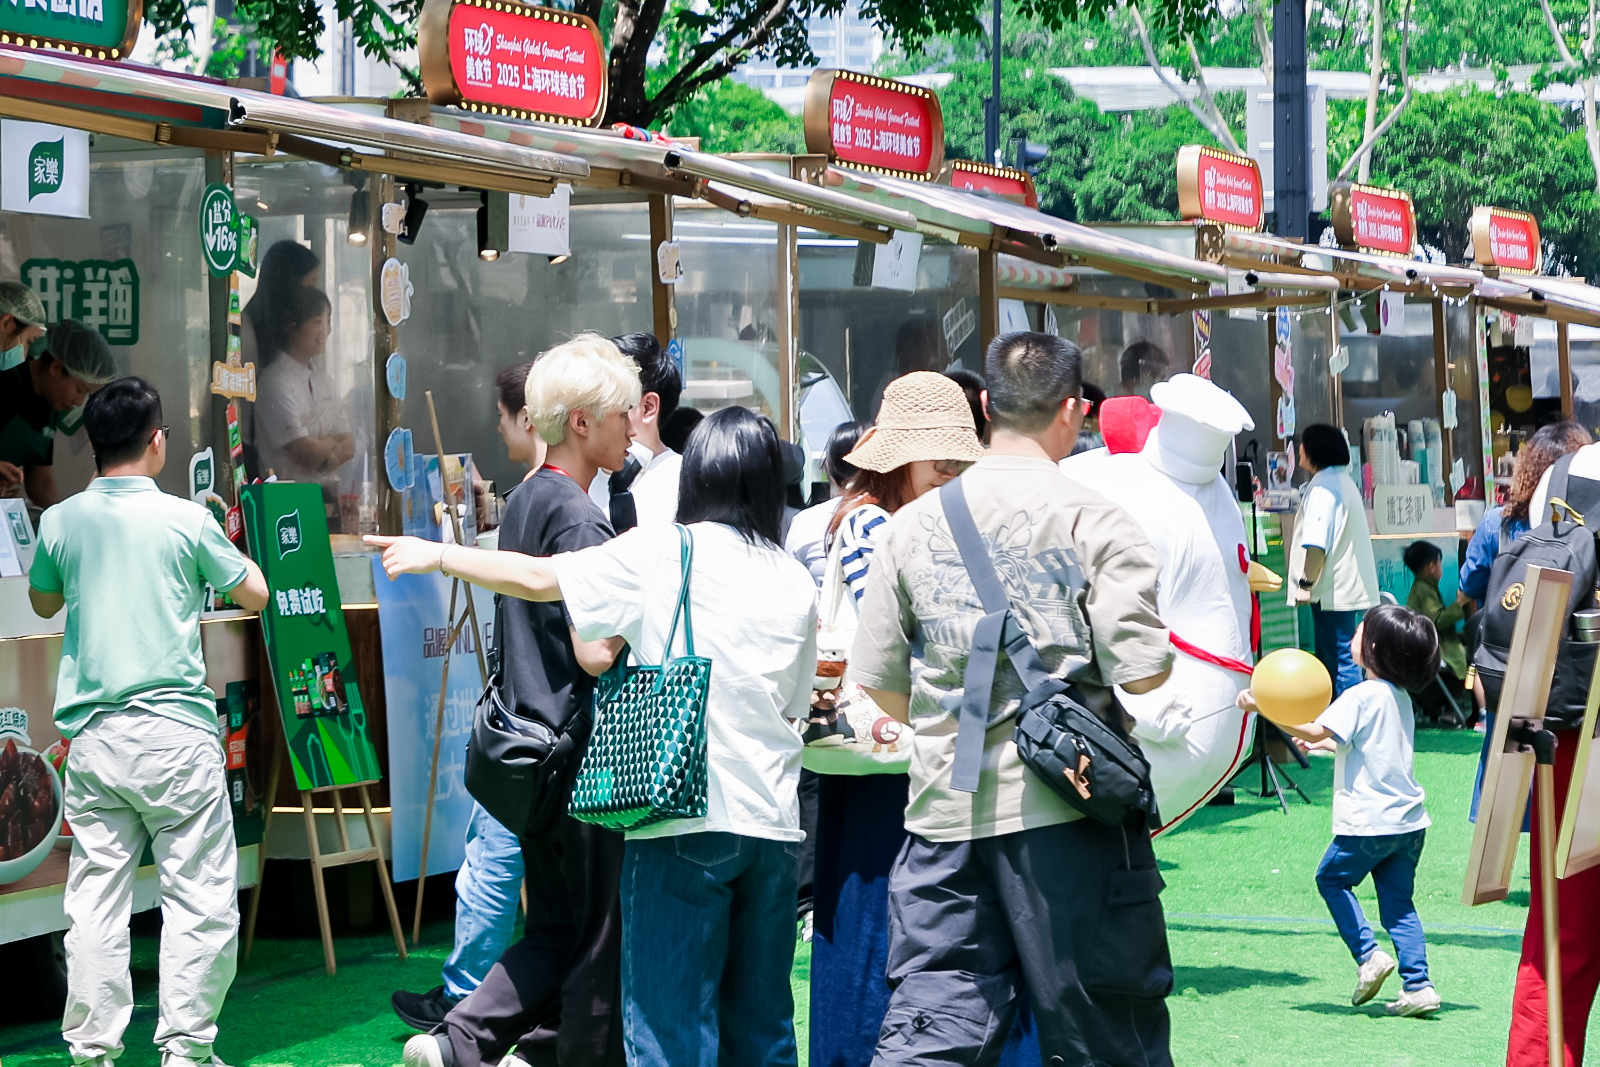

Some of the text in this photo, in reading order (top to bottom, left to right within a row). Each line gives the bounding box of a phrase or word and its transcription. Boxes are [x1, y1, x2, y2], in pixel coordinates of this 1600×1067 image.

[496, 62, 586, 102] 2025 上海环球美食节
[855, 126, 872, 149] 2025
[33, 155, 61, 187] 家樂
[212, 200, 232, 222] 盐分
[215, 225, 238, 253] 16%
[279, 525, 301, 545] 家樂
[275, 588, 328, 617] 免费试吃
